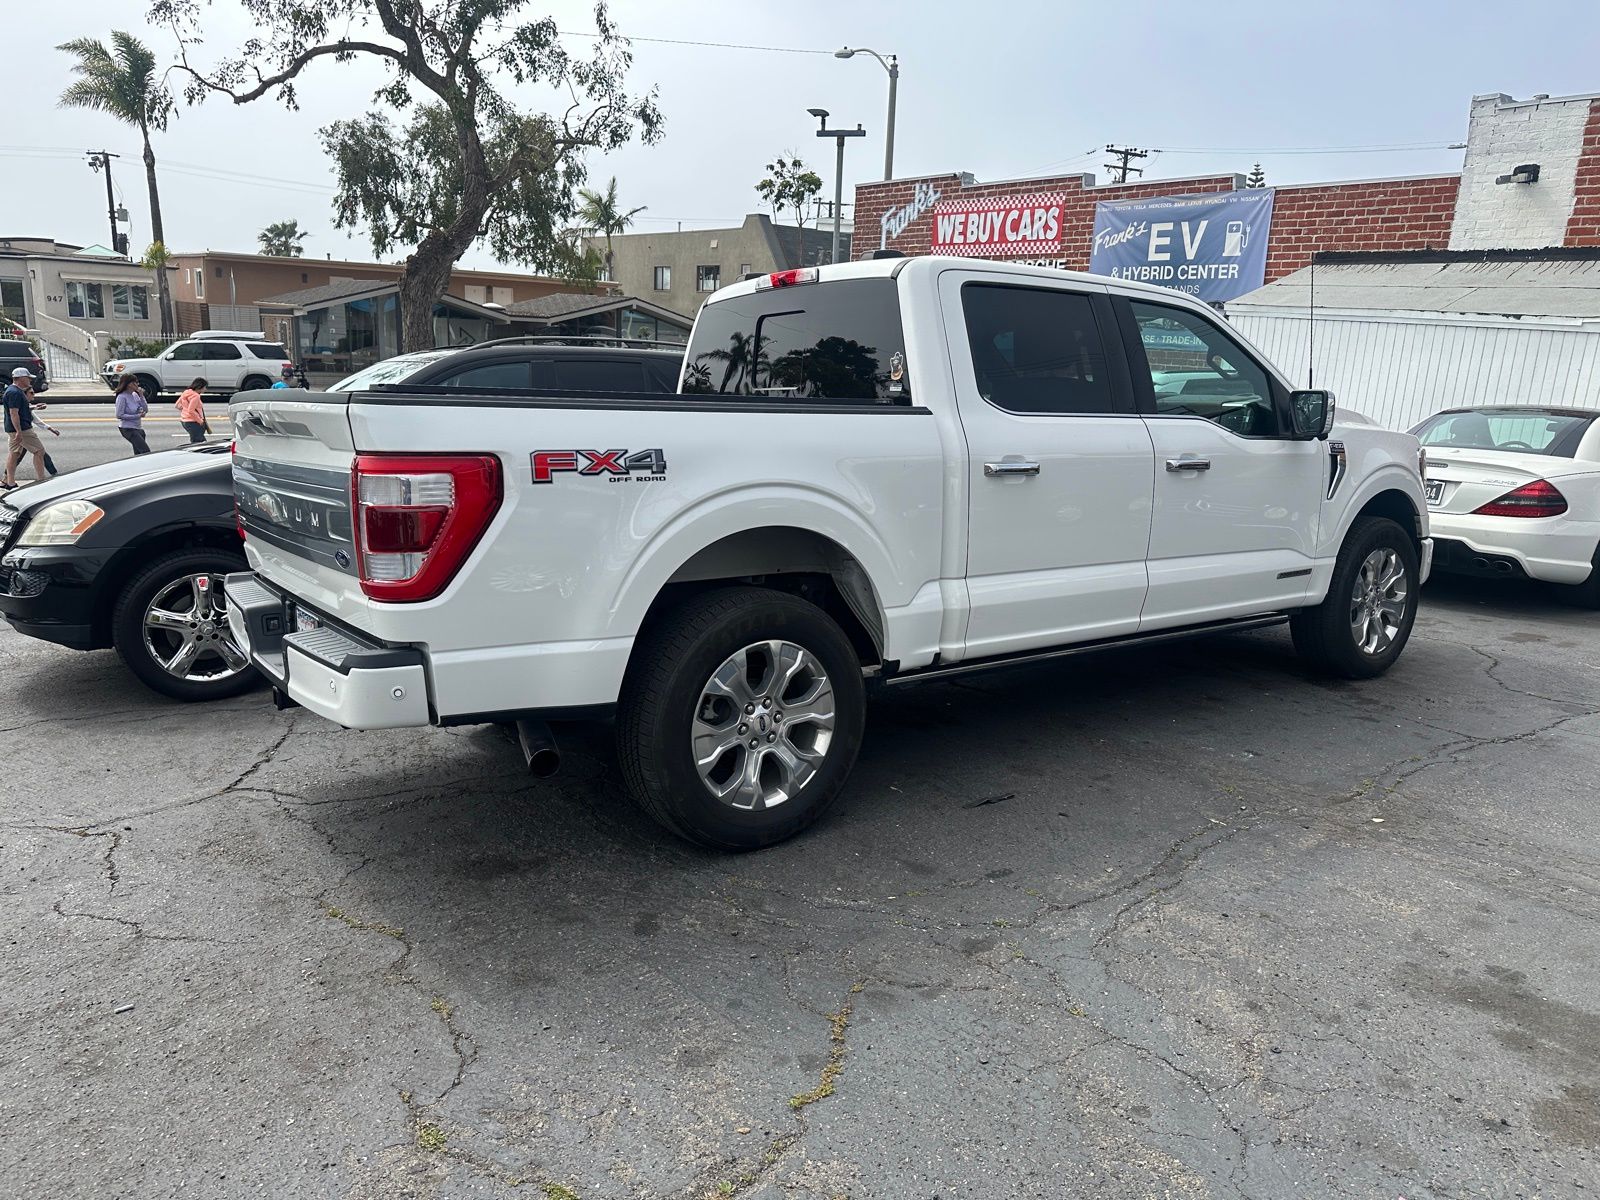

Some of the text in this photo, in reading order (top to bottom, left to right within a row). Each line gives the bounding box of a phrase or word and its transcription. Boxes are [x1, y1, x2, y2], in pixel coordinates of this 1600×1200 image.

[937, 206, 1060, 244] WE BUY CARS
[1094, 220, 1208, 261] Frank's EV
[1110, 264, 1239, 280] & HYBRID CENTER
[1161, 285, 1200, 293] ANDS
[529, 448, 667, 484] FX4
[241, 491, 320, 527] PLANUM
